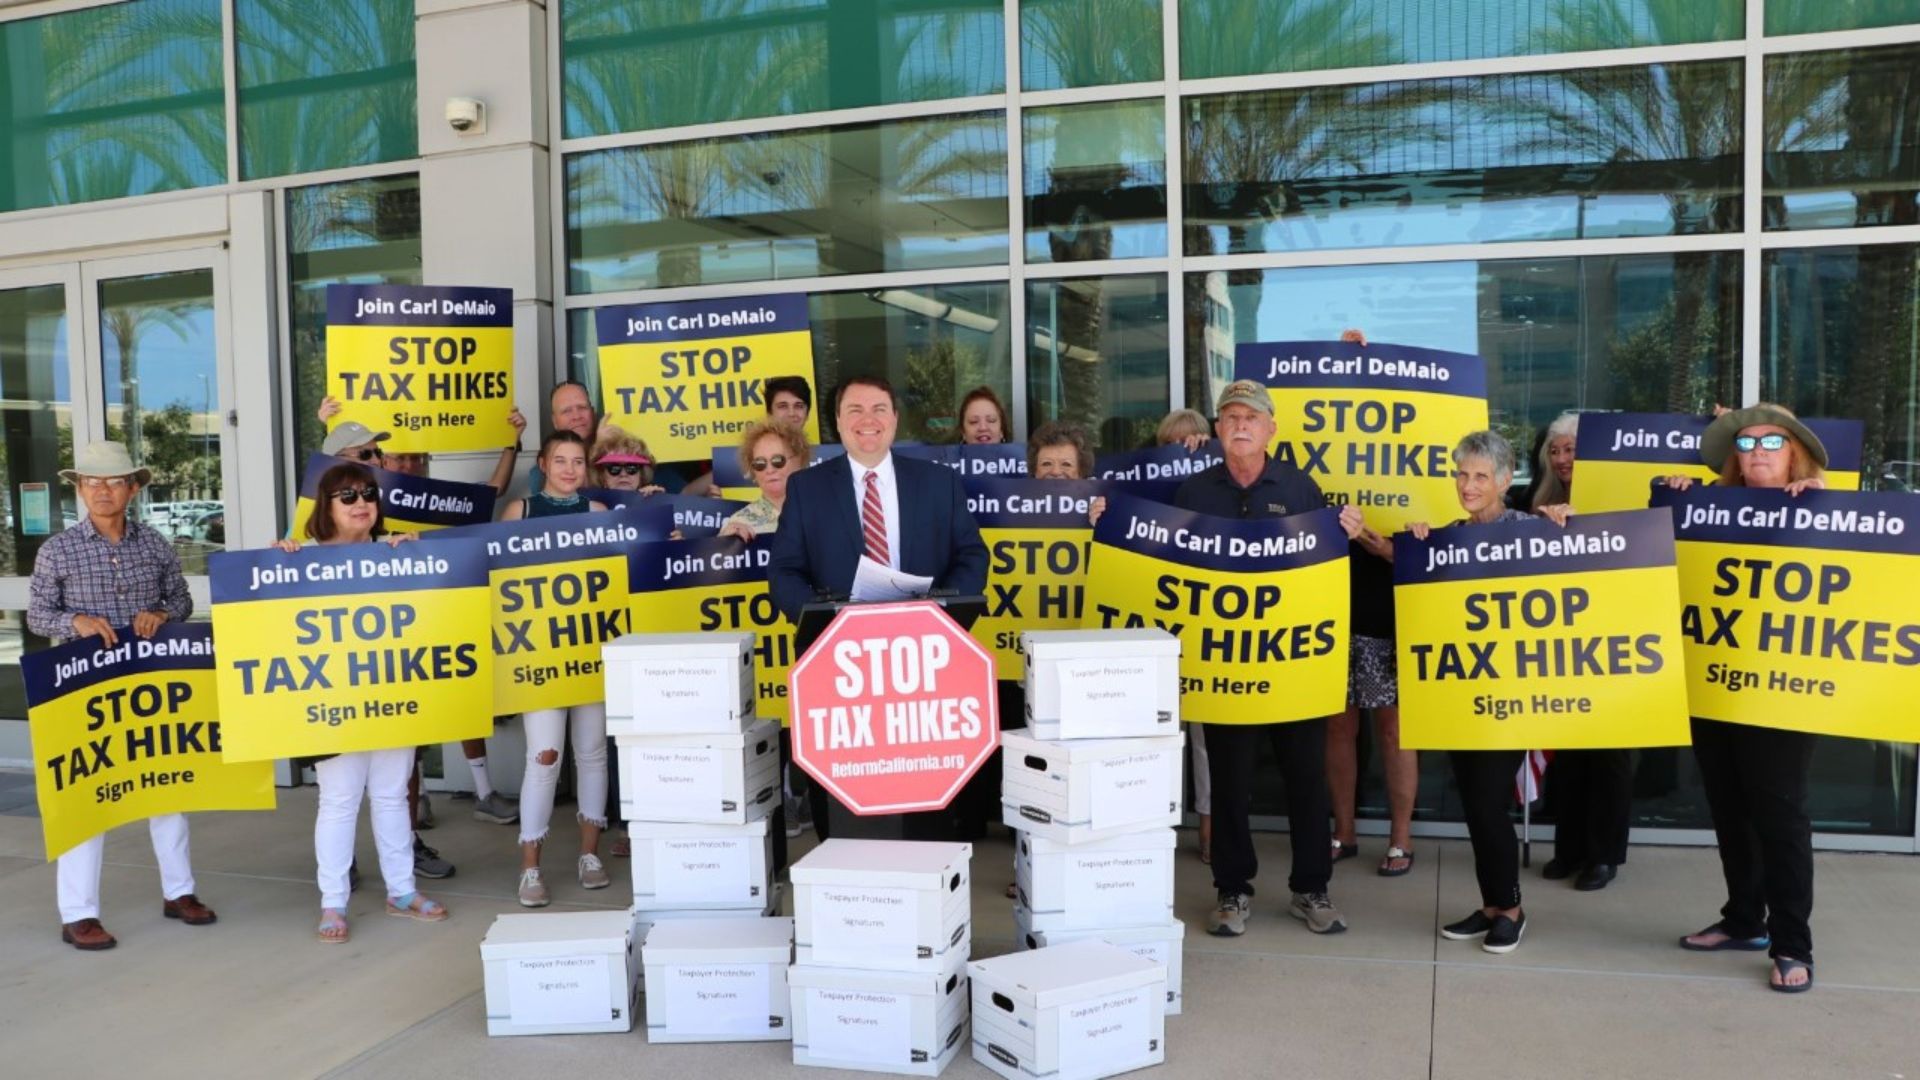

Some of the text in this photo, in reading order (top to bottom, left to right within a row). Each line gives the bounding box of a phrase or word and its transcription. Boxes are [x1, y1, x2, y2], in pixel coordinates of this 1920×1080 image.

[355, 298, 496, 318] Join Carl DeMaio
[627, 307, 777, 336] Join Carl DeMaio
[389, 336, 477, 365] STOP
[660, 346, 752, 379] STOP
[1267, 356, 1450, 382] Join Carl DeMaio
[339, 371, 508, 401] TAX HIKES
[616, 379, 765, 415] TAX HIK
[393, 412, 475, 431] Sign Here
[669, 421, 708, 440] Sign
[1303, 400, 1417, 435] STOP
[1612, 428, 1702, 451] Join Car
[972, 458, 1028, 475] DeMa
[1103, 464, 1141, 481] Carl
[1272, 440, 1332, 475] AX
[389, 488, 427, 510] Carl
[428, 494, 474, 515] DeMaio
[967, 493, 1000, 513] oin
[1006, 495, 1051, 514] Carl
[1323, 490, 1410, 509] gn Here
[673, 510, 729, 529] eMai
[1681, 503, 1905, 536] Join Carl DeMaio
[507, 531, 551, 554] Carl
[557, 523, 638, 549] DeMaio
[1126, 516, 1317, 557] Join Carl DeMaio
[1426, 531, 1627, 572] Join Carl DeMaio
[250, 555, 449, 590] Join Carl DeMaio
[664, 555, 704, 580] Join
[710, 550, 750, 570] Carl
[1713, 557, 1852, 605] STOP
[500, 570, 610, 613] STOP
[1155, 574, 1282, 620] STOP
[295, 603, 416, 645] STOP
[700, 593, 781, 631] STO
[1465, 587, 1590, 632] STOP
[549, 607, 632, 649] HIK
[1200, 619, 1336, 663] HIKES
[1681, 604, 1920, 667] AX HIKES
[54, 637, 217, 687] Join Carl DeMai
[233, 642, 478, 696] TAX HIKES
[514, 660, 603, 686] Sign Her
[834, 634, 950, 699] STOP
[1410, 633, 1664, 682] TAX HIKES
[759, 682, 788, 699] He
[1179, 676, 1271, 695] gn Here
[1705, 663, 1836, 697] Sign Here
[86, 682, 193, 731] STOP
[306, 699, 419, 727] Sign Here
[1473, 694, 1592, 721] Sign Here
[808, 696, 981, 751] TAX HIKES
[47, 721, 223, 792] TAX HIKE
[831, 754, 965, 779] ReformCalifornia.org
[95, 770, 195, 804] Sign Here
